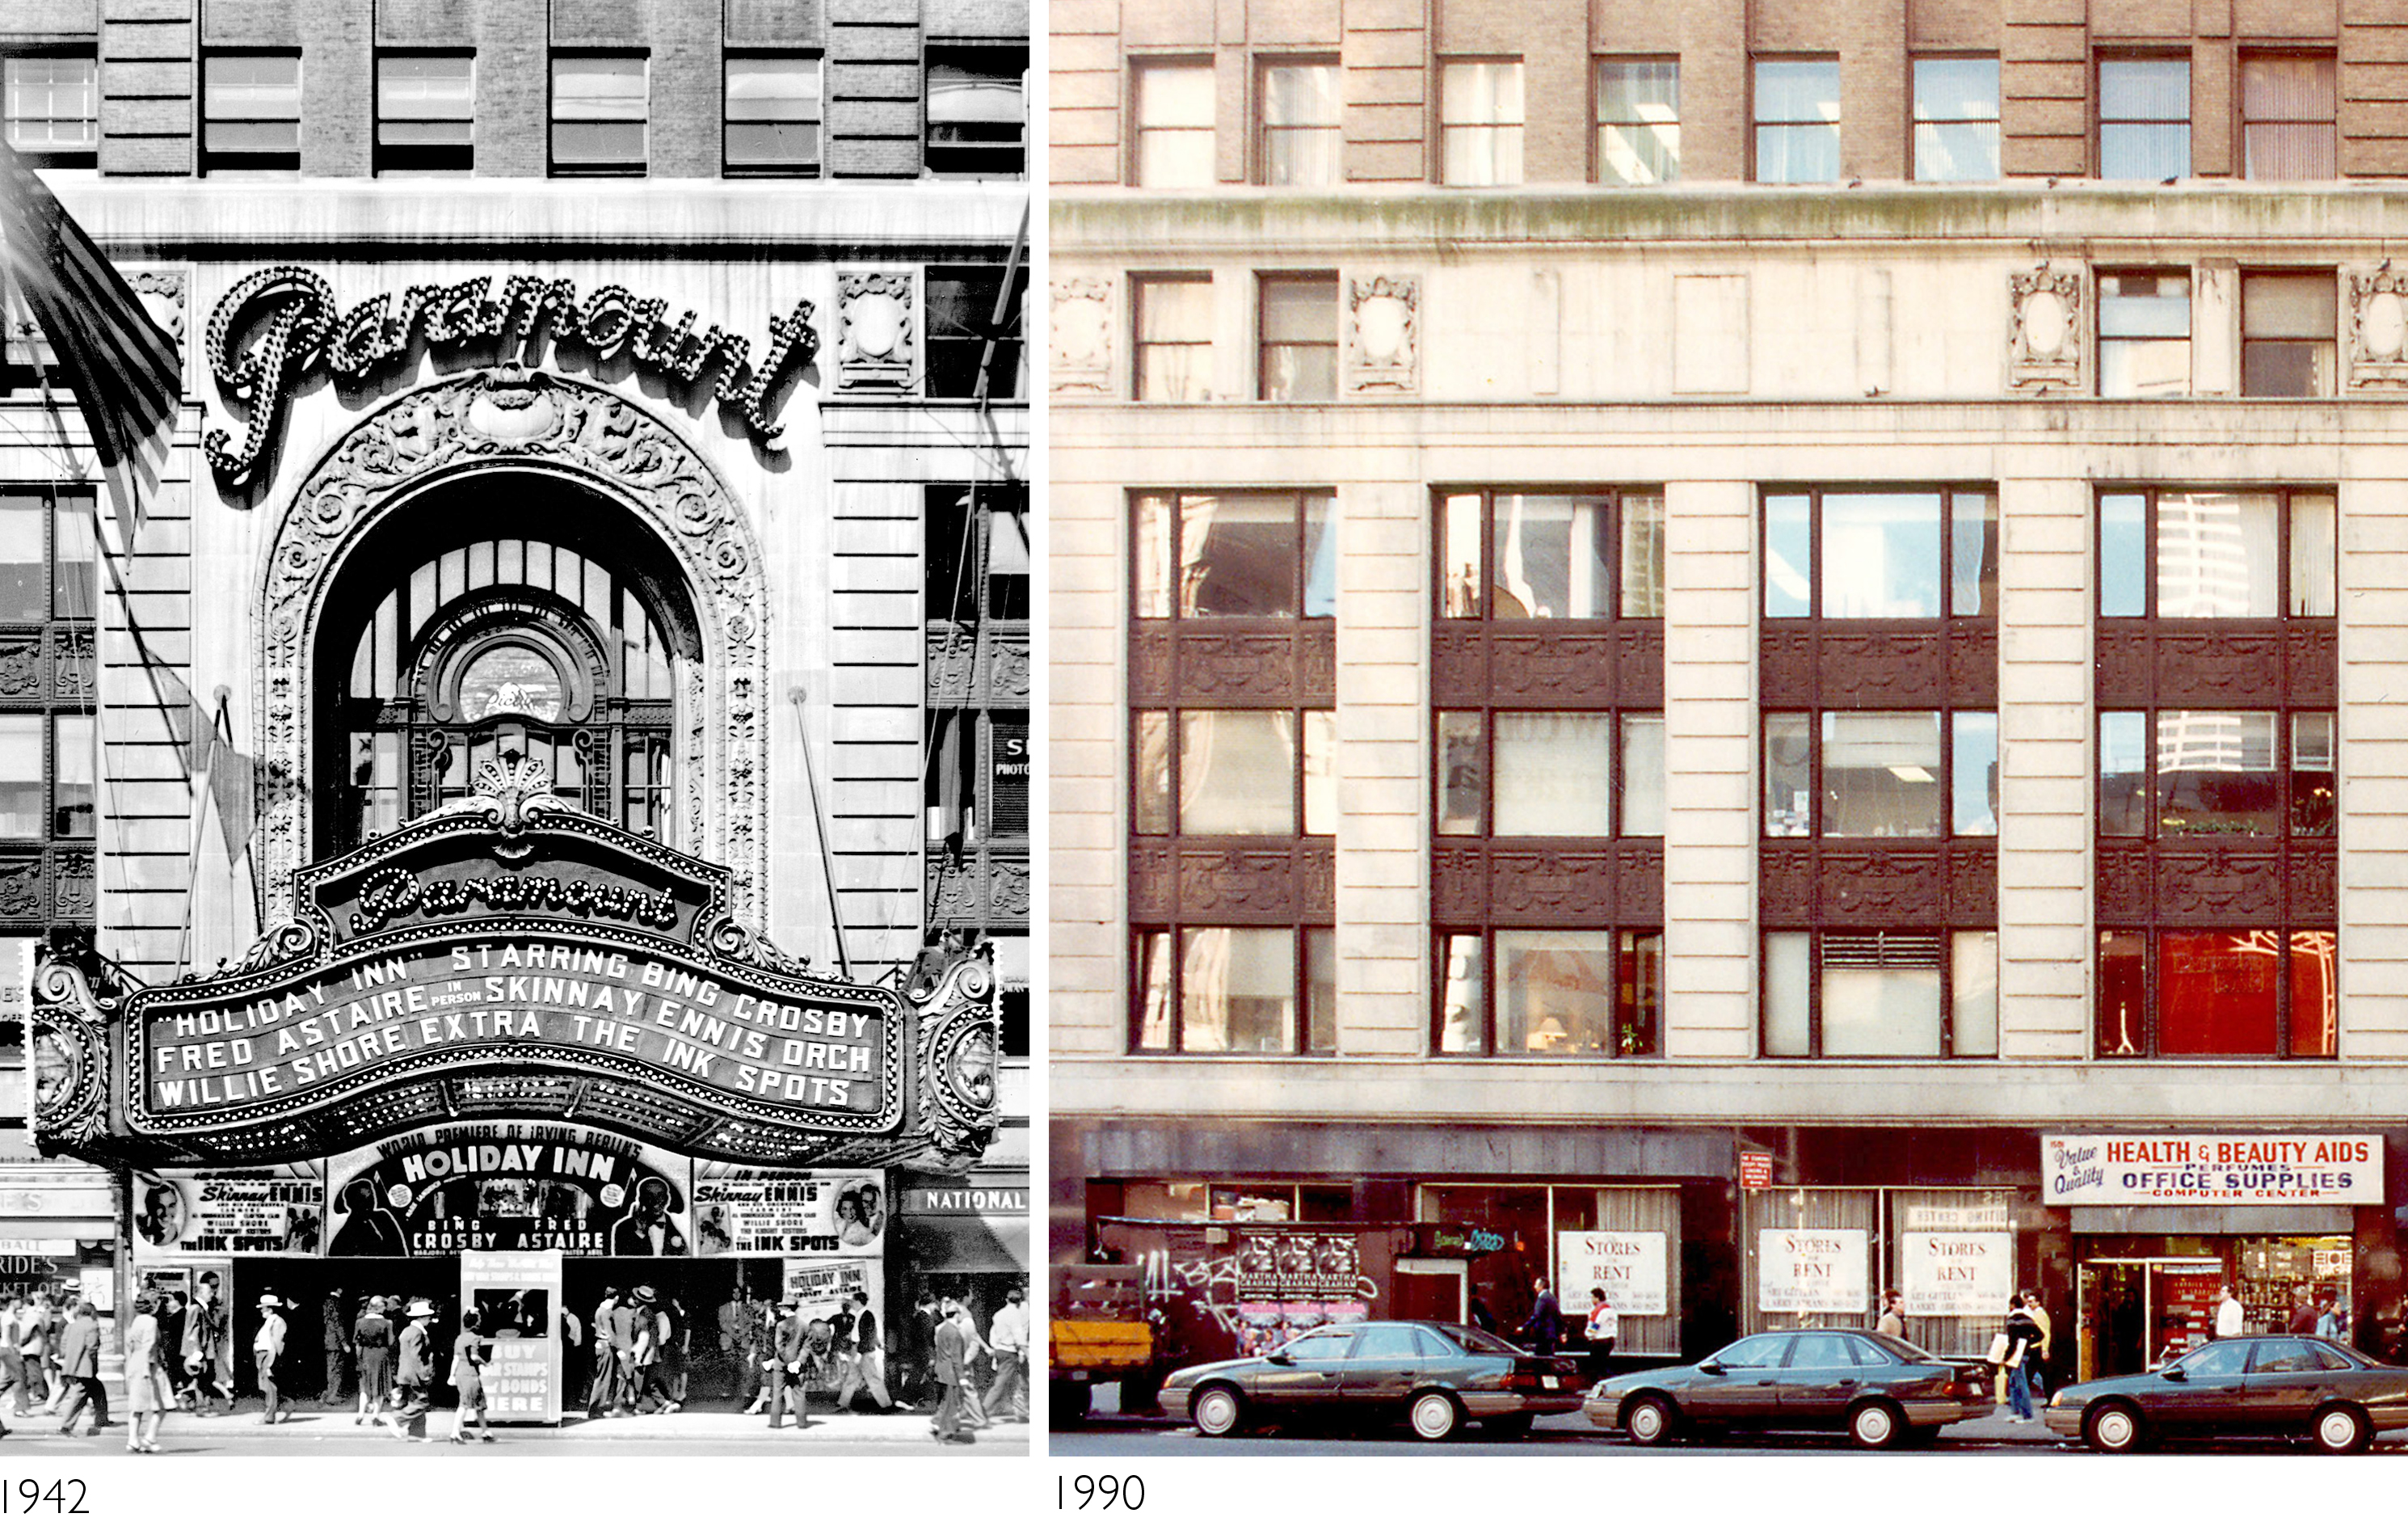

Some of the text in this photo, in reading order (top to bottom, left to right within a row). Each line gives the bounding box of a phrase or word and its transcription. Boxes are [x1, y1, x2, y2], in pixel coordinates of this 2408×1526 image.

[205, 265, 813, 475] Paramount
[350, 867, 677, 936] Paramount
[447, 980, 462, 993] IN
[452, 943, 628, 980] STARRING
[641, 963, 721, 1005] BING
[733, 994, 870, 1038] CROSBY
[432, 991, 482, 1007] PERSON
[158, 985, 428, 1073] FRED ASTAIRE
[486, 976, 870, 1073] SKINNAY ENNIS ORCH
[158, 1010, 850, 1108] WILLIE SHORE EXTRA THE INK SPOTS
[2055, 1146, 2098, 1170] Value
[2107, 1141, 2369, 1164] HEALTH & BEAUTY AIDS
[402, 1144, 615, 1183] HOLIDAY INN
[2185, 1164, 2291, 1172] PERFUMES
[2054, 1166, 2104, 1195] Quality
[2122, 1172, 2353, 1189] OFFICE SUPPLIES
[269, 1187, 322, 1203] ENNIS
[764, 1186, 818, 1202] ENNIS
[927, 1191, 1027, 1209] NATIONAL
[2152, 1189, 2320, 1198] COMPUTER CENTER
[427, 1219, 480, 1231] BING
[534, 1219, 587, 1231] FRED
[180, 1235, 283, 1251] THE INK SPOTS
[413, 1232, 497, 1249] CROSBY
[517, 1232, 604, 1249] ASTAIRE
[736, 1235, 840, 1251] THE INK SPOTS
[1585, 1237, 1640, 1255] STORES
[1785, 1234, 1842, 1253] STORES
[1928, 1237, 1987, 1256] STORES
[790, 1271, 835, 1288] HOLIDAY
[840, 1269, 861, 1284] INN
[1593, 1265, 1633, 1280] RENT
[1793, 1263, 1833, 1278] RENT
[1937, 1267, 1978, 1281] RENT
[491, 1344, 537, 1359] BUY
[500, 1379, 548, 1394] BONDS
